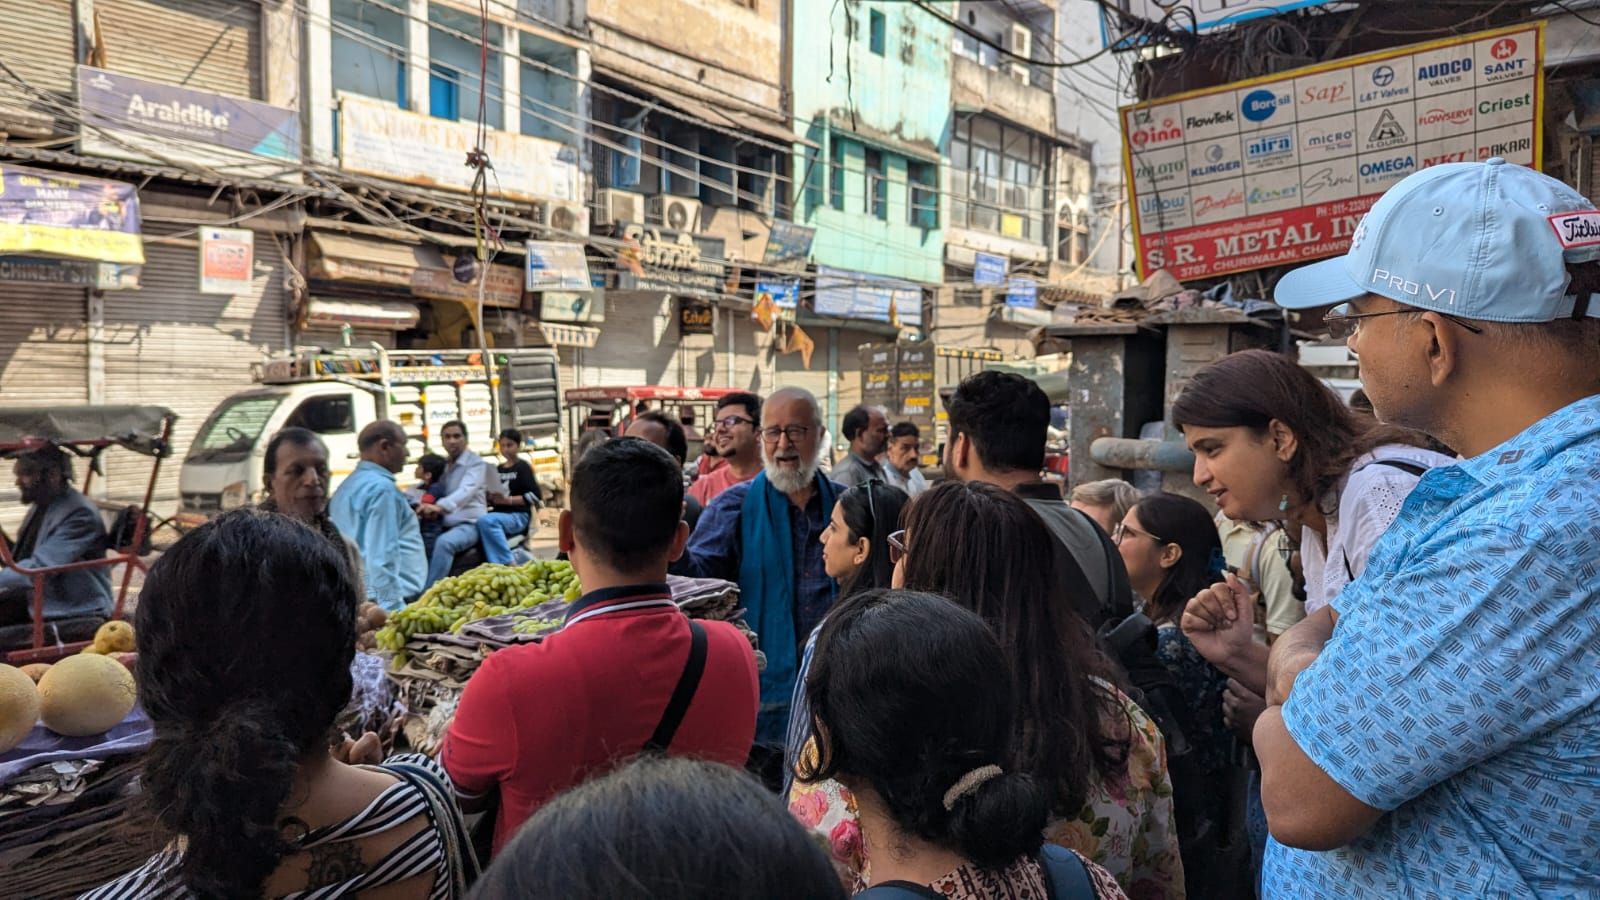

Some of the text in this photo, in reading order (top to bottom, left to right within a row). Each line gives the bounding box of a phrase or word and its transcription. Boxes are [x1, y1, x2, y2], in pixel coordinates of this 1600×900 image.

[1417, 58, 1473, 81] AUDCO
[1484, 58, 1528, 75] SANT
[1429, 76, 1462, 87] VALVES
[1301, 83, 1346, 105] Sap
[1360, 87, 1409, 103] L&T Valves
[1478, 92, 1531, 115] Criest
[128, 94, 229, 131] Araldite
[1186, 111, 1234, 130] FlowTek
[1418, 108, 1474, 126] FLOWSERVE
[1249, 138, 1290, 155] aira
[1490, 138, 1530, 156] AKARI
[1190, 161, 1241, 178] KLINGER
[1360, 156, 1414, 177] OMEGA
[1563, 216, 1600, 242] Titlei
[1147, 243, 1204, 270] S.R.
[1215, 223, 1321, 257] METAL
[1425, 283, 1456, 305] V1
